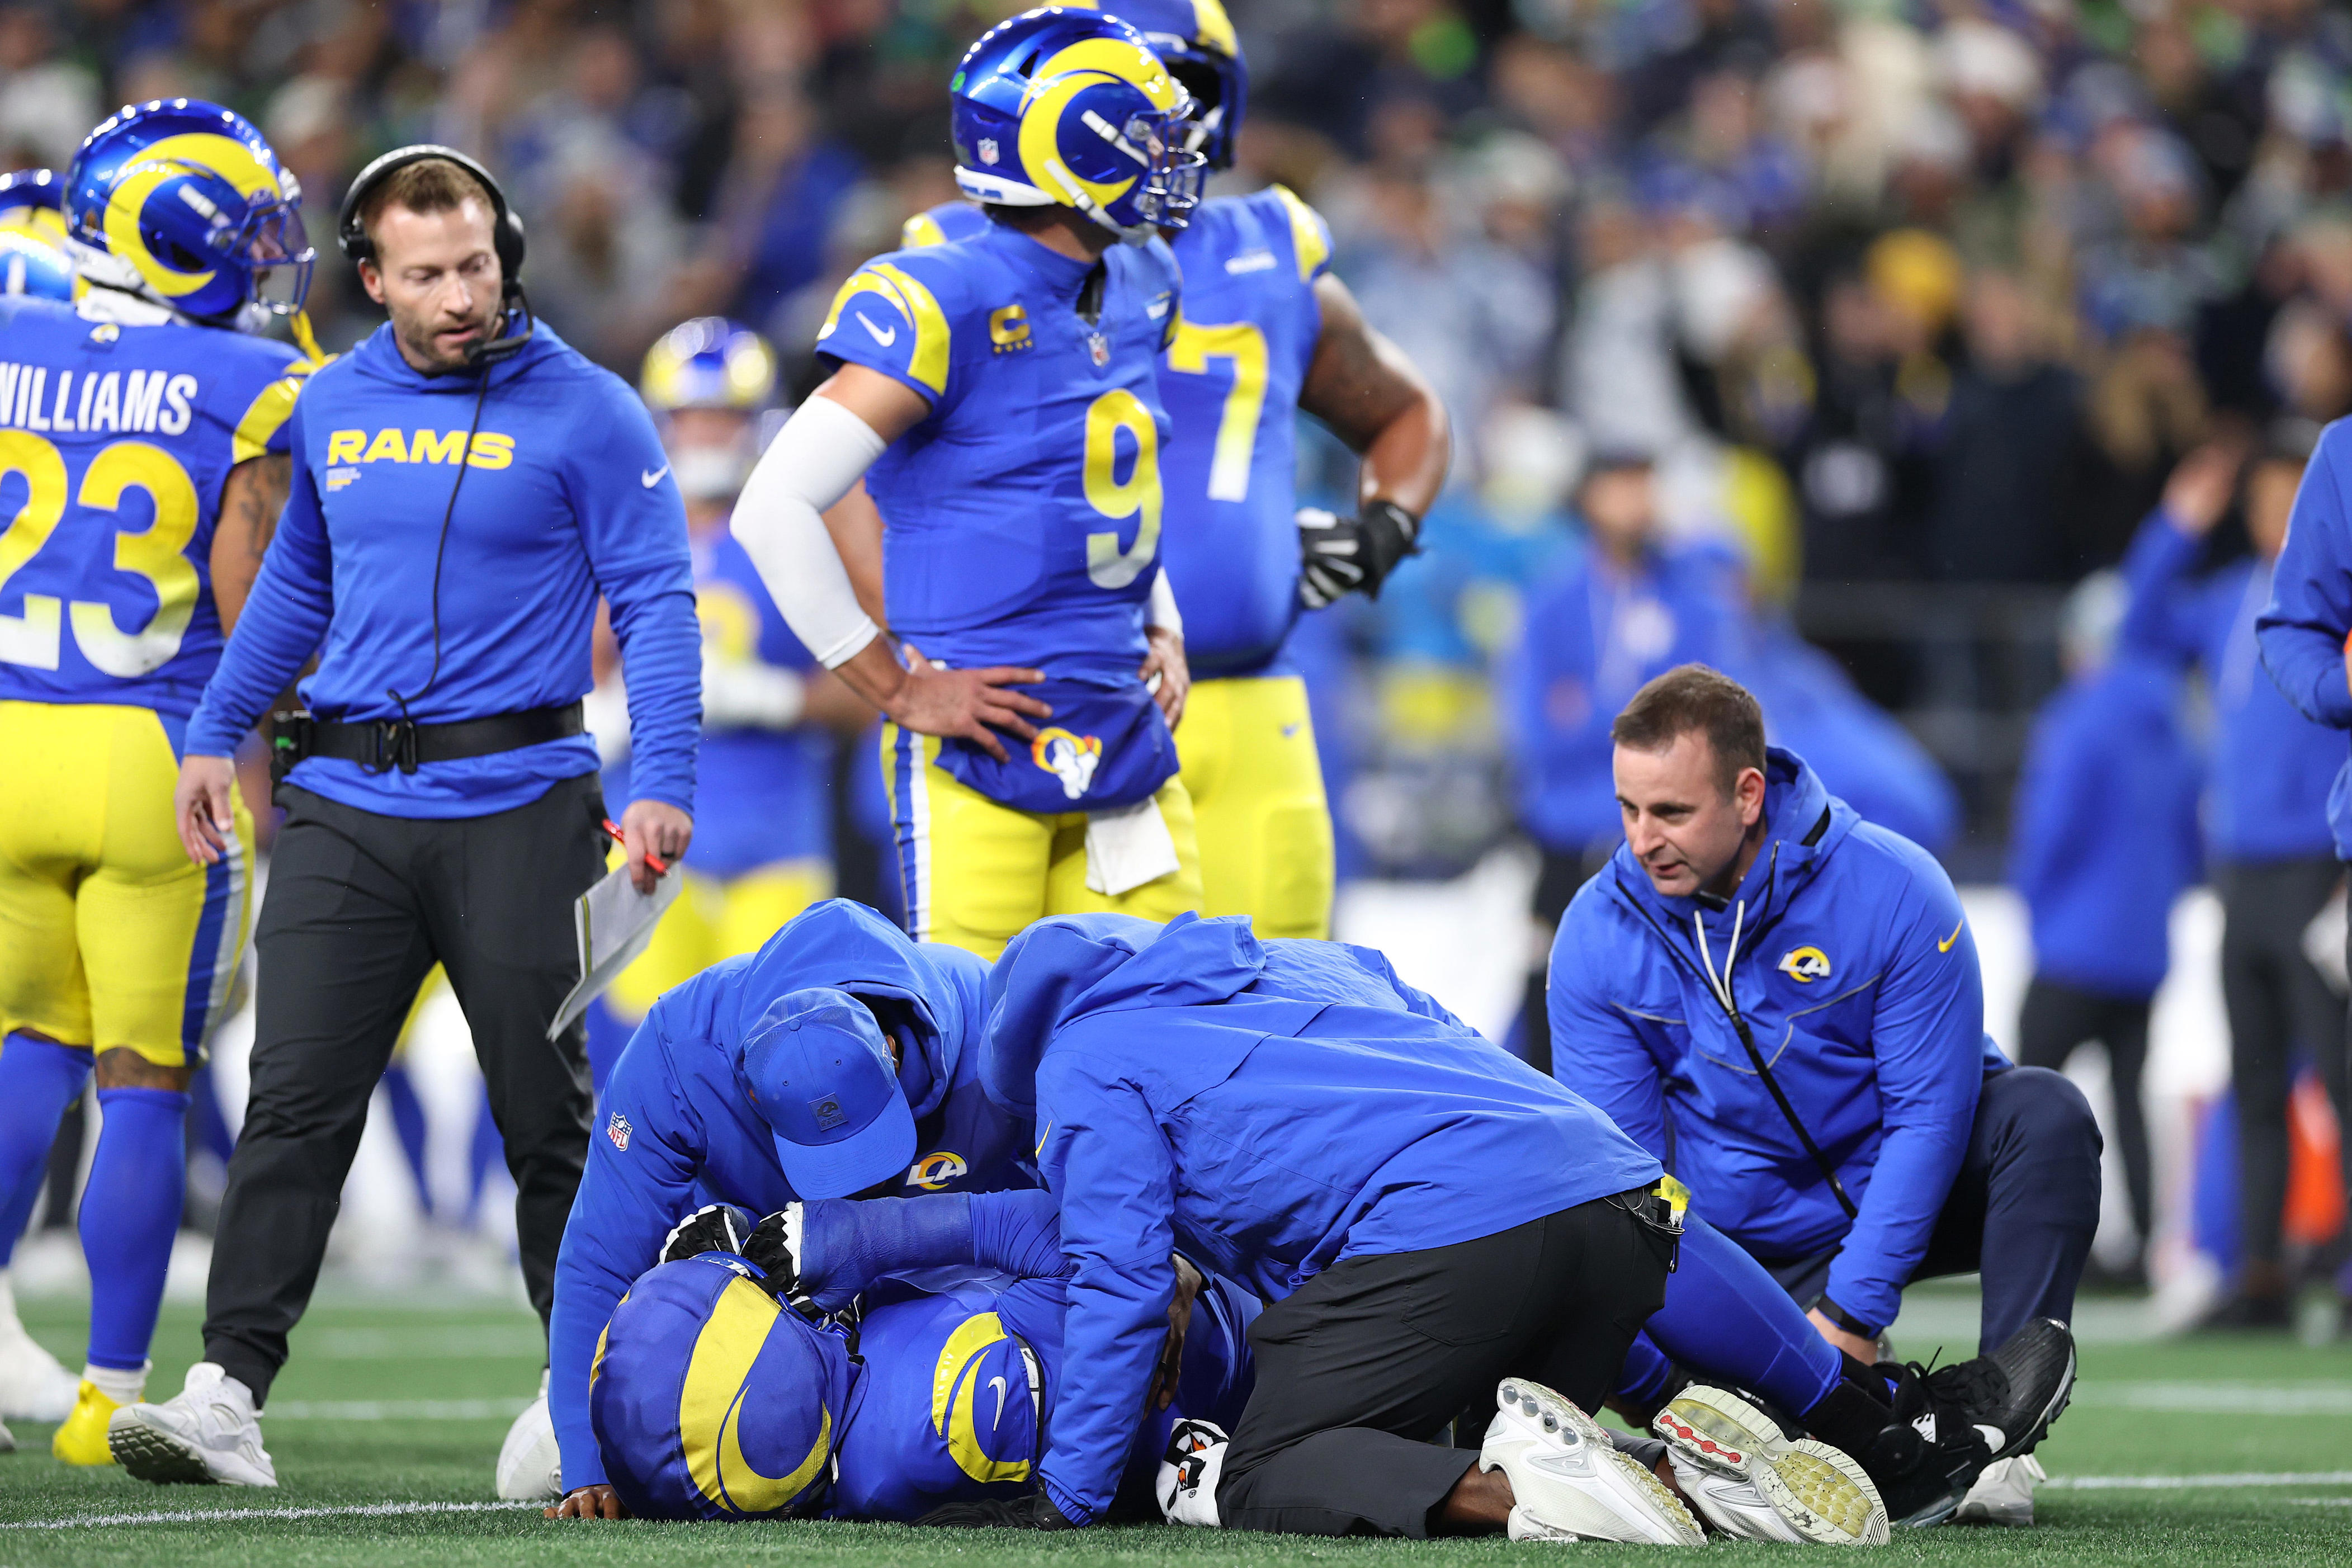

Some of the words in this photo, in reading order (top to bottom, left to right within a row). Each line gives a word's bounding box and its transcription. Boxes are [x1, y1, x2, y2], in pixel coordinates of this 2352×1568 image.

[327, 428, 516, 470] RAMS
[1082, 388, 1164, 589] 9
[0, 427, 200, 678] 23
[610, 1126, 625, 1147] NFL
